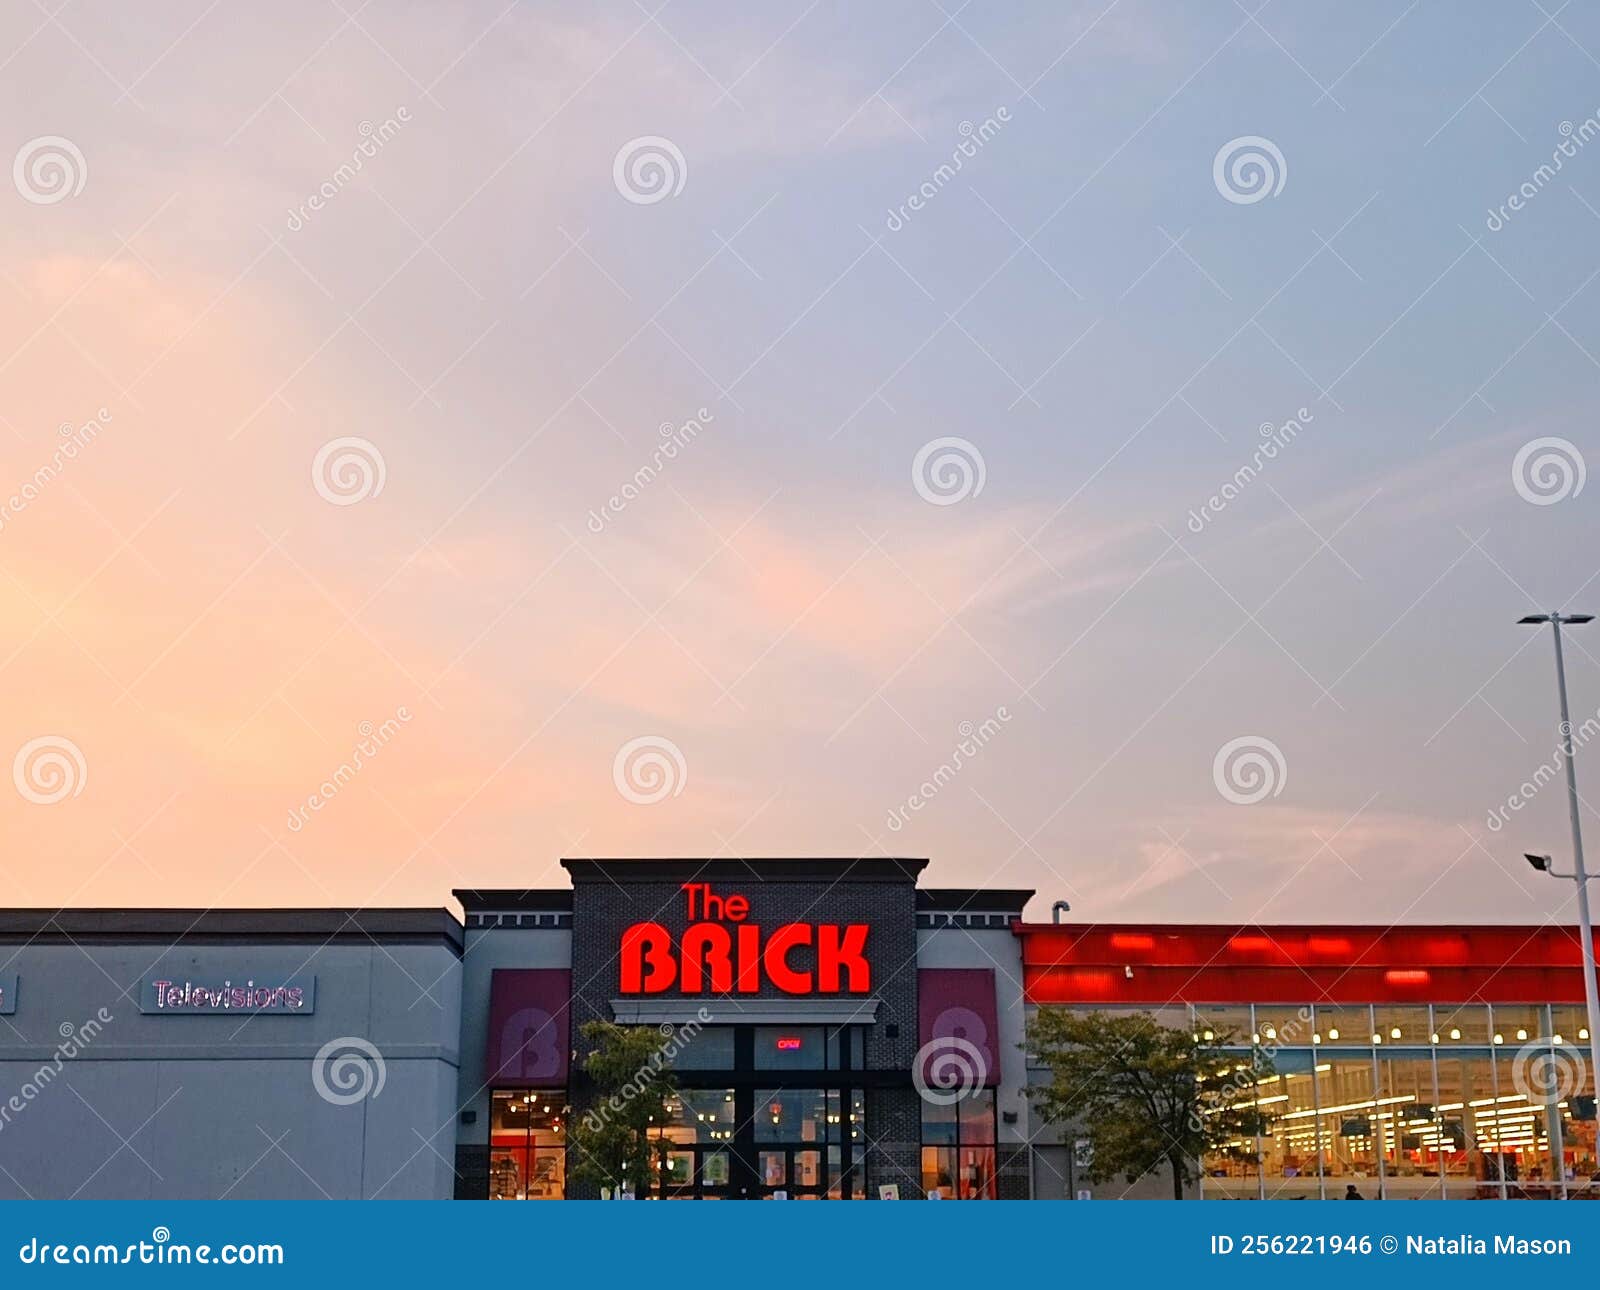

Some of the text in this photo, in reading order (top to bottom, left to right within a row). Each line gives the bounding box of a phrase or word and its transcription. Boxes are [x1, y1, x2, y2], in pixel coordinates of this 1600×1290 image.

[682, 883, 749, 921] The
[620, 922, 870, 994] BRICK
[153, 980, 304, 1009] Televisions
